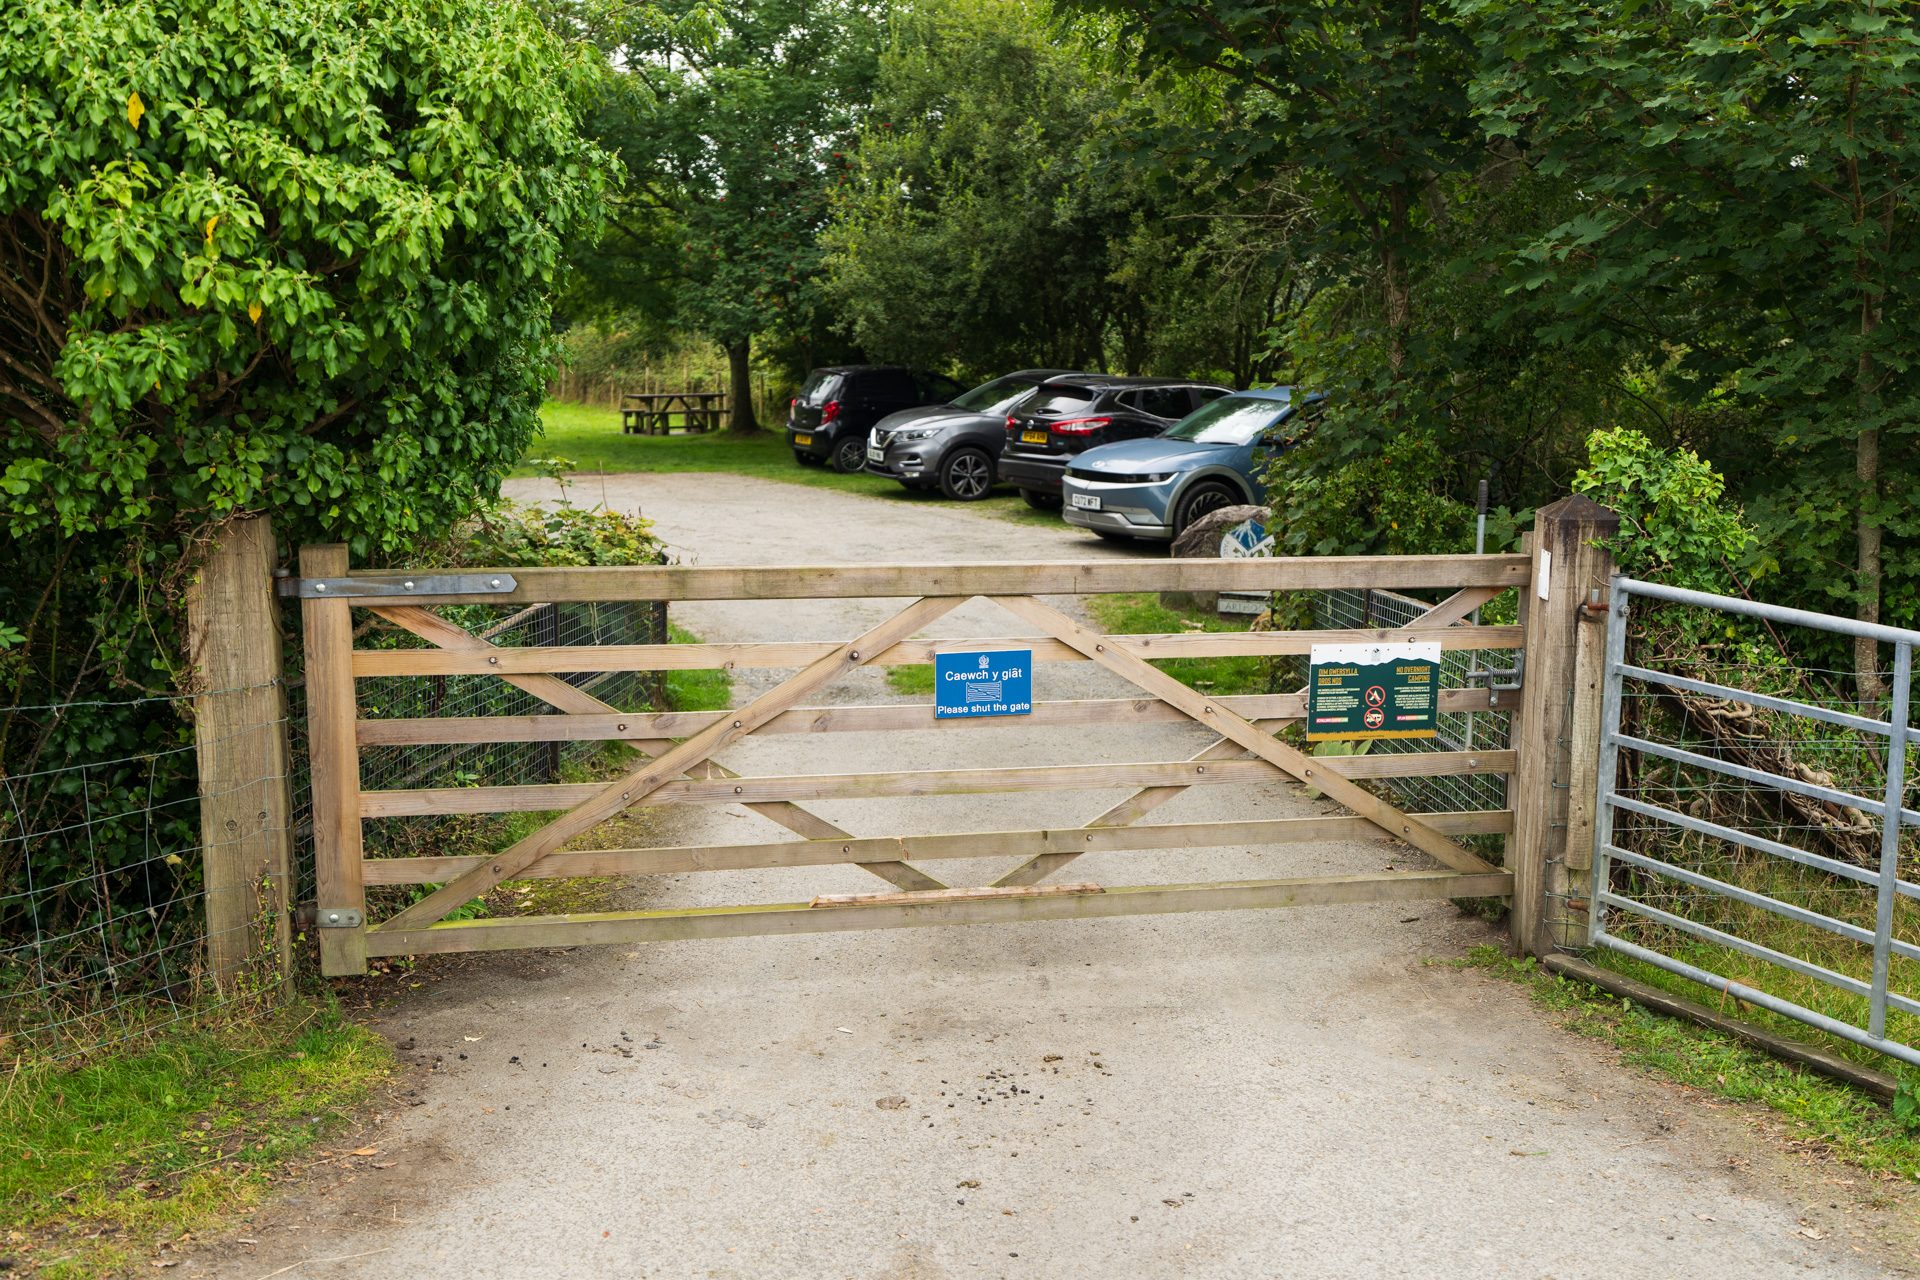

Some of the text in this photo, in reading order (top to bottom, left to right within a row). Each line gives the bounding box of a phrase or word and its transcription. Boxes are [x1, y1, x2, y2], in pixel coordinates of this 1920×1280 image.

[1404, 665, 1431, 673] OVERNIGHT
[945, 668, 1022, 681] Caewch y giât
[1318, 677, 1331, 685] DROS
[938, 702, 1030, 714] Please shut the gate
